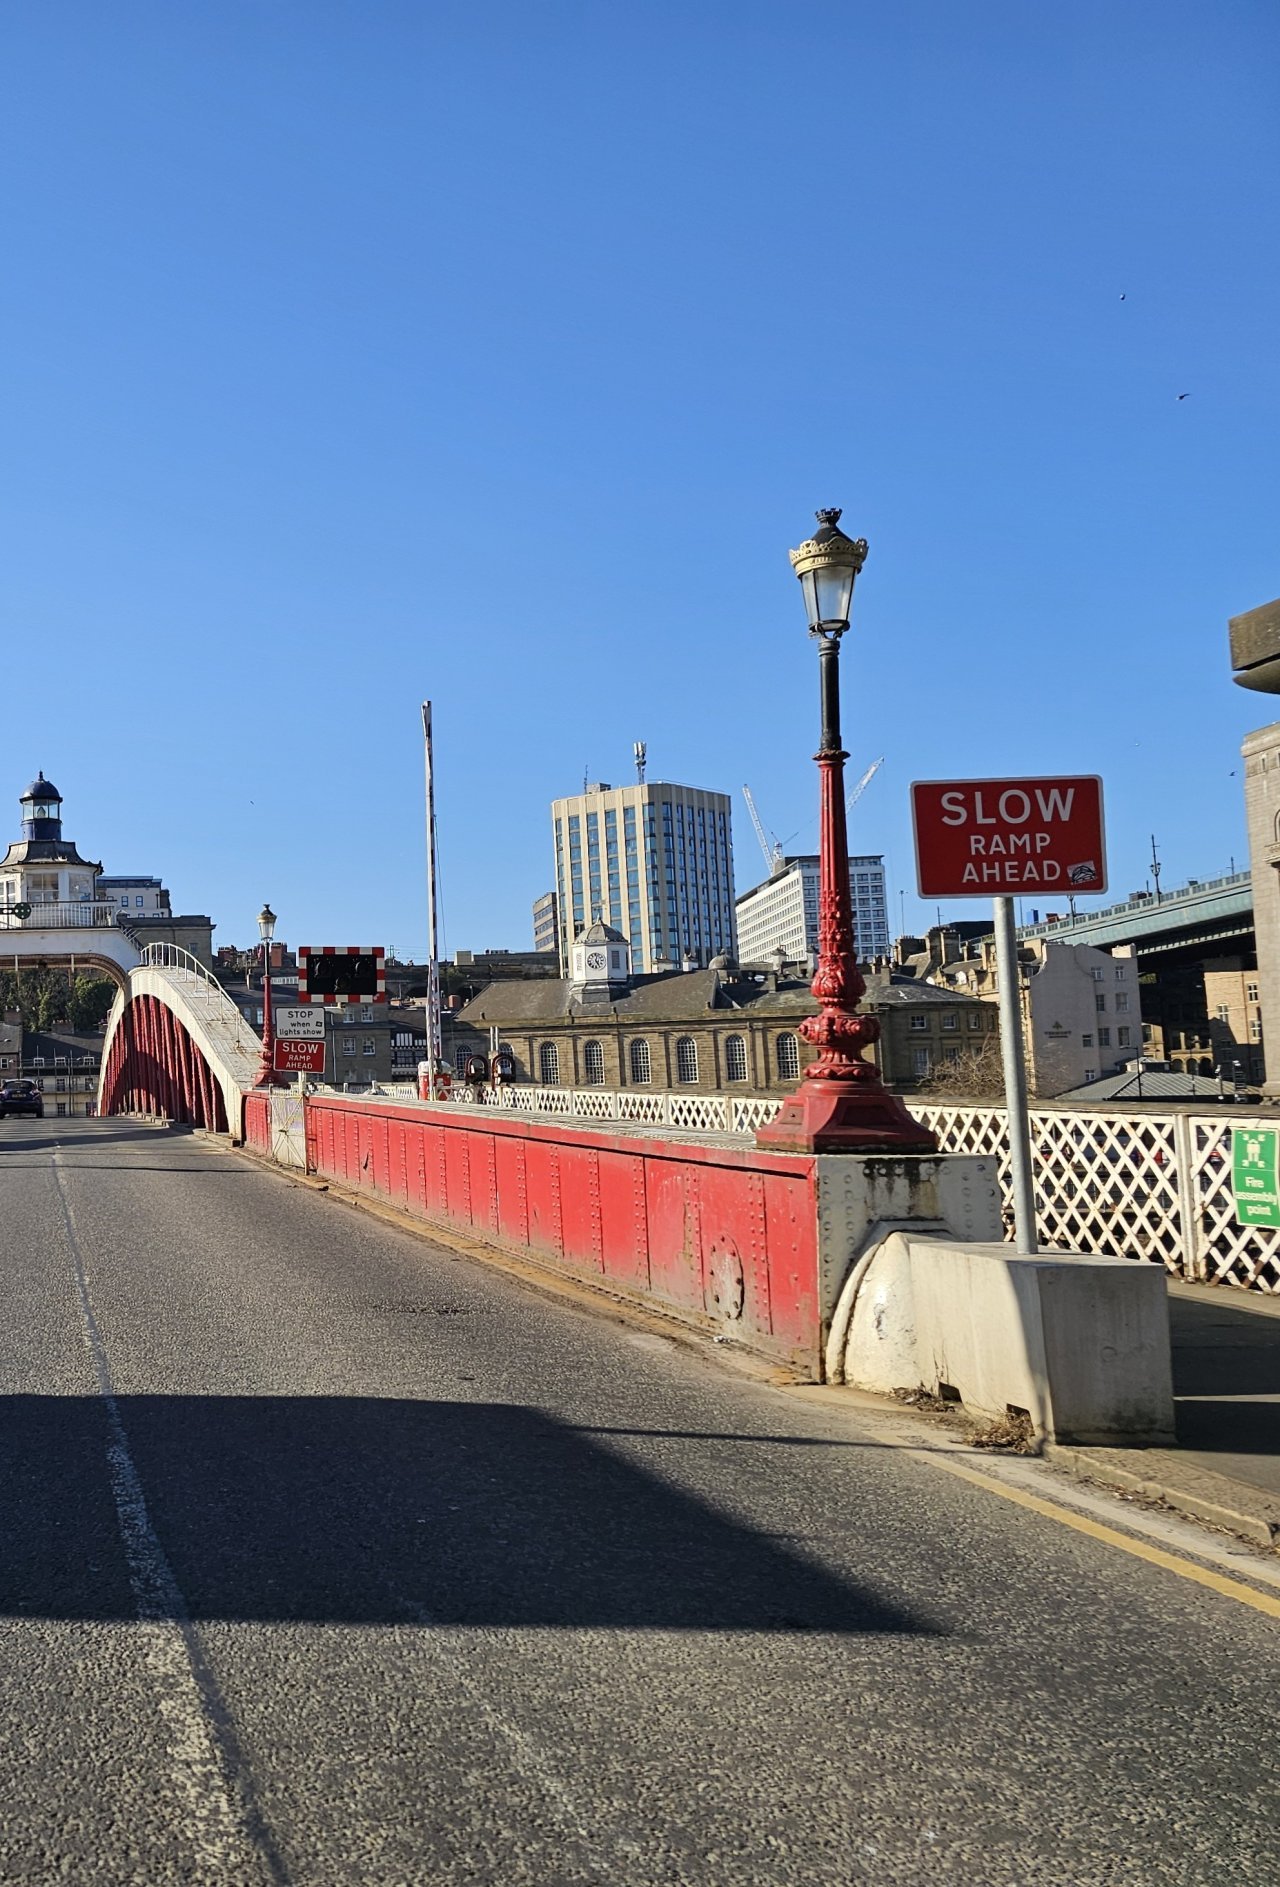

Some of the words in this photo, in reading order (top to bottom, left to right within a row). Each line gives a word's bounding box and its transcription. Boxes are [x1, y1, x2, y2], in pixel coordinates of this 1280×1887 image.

[941, 788, 1075, 826] SLOW
[970, 833, 1051, 855] RAMP
[962, 860, 1061, 883] AHEAD
[287, 1010, 313, 1018] STOP
[282, 1042, 318, 1053] SLOW
[288, 1054, 311, 1062] RAMP
[285, 1061, 313, 1070] AHEAD
[1244, 1176, 1264, 1188] Fire
